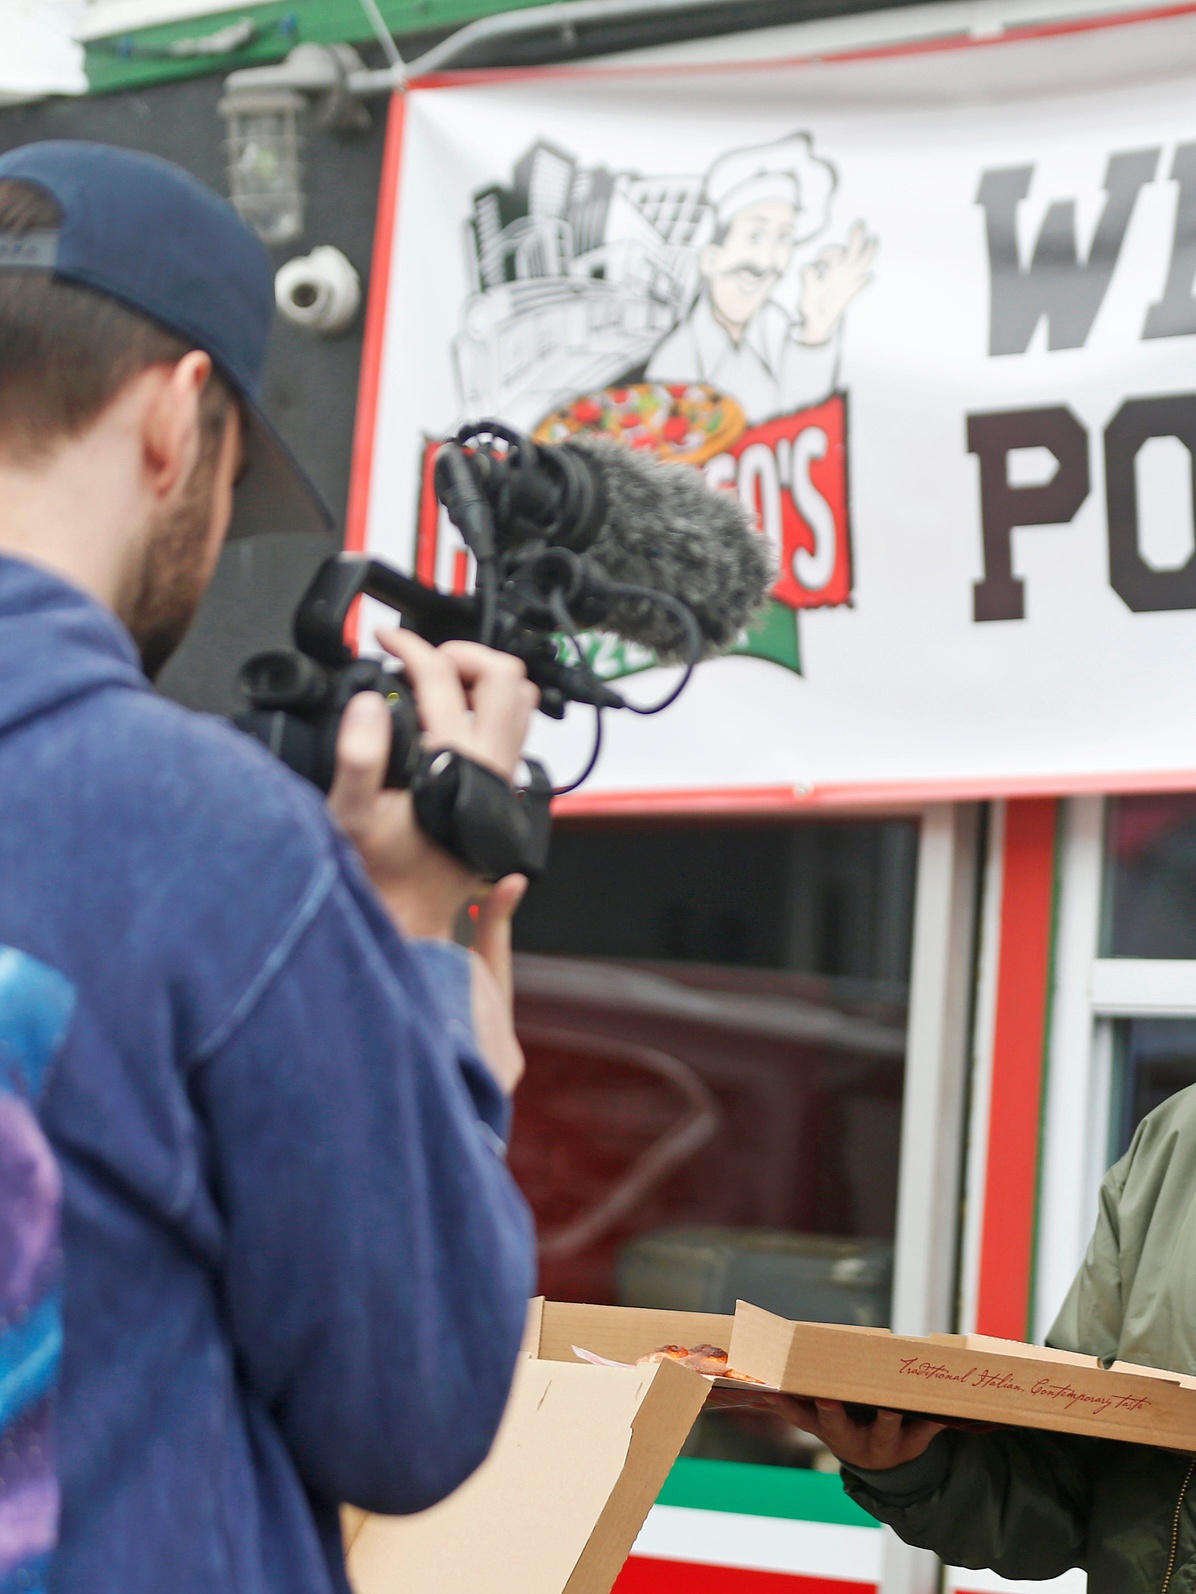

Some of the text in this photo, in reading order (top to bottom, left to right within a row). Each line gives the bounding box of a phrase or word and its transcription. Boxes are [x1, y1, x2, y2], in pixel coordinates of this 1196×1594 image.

[899, 1357, 978, 1383] Traditional
[972, 1369, 1025, 1393] Italian,
[1030, 1378, 1112, 1416] Contemporary
